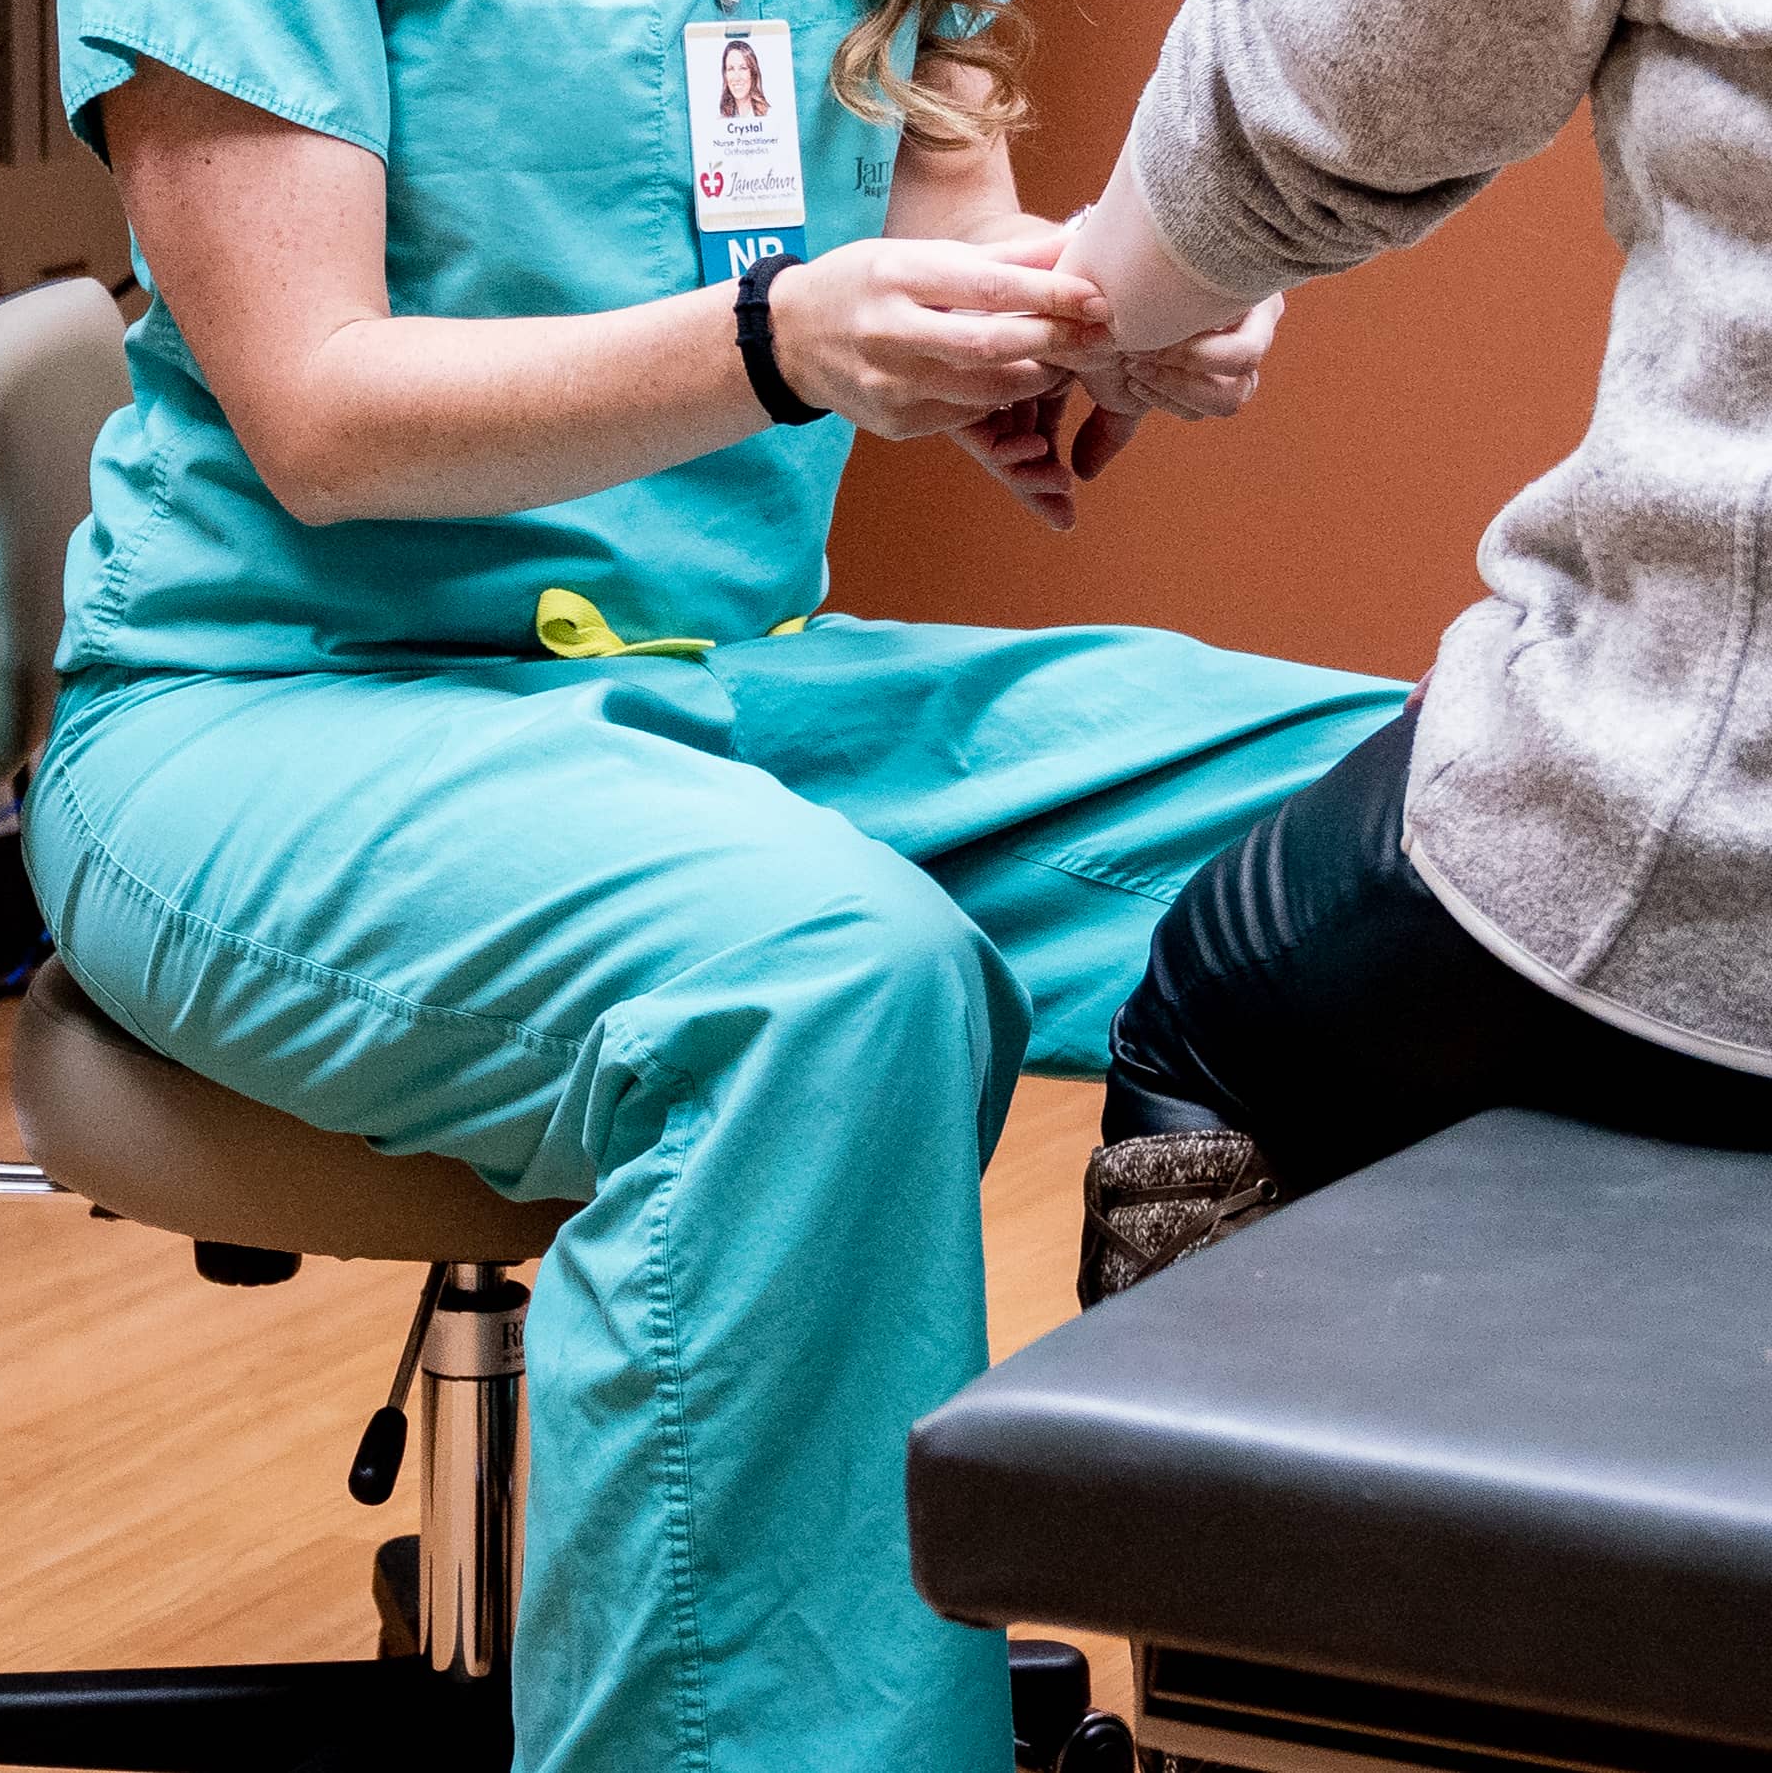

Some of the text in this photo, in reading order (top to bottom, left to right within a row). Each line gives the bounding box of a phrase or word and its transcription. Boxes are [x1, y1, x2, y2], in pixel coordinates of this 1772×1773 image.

[727, 121, 763, 136] Crystal
[713, 137, 778, 148] Nurse Practitioner
[726, 168, 796, 197] Jamestown
[728, 236, 784, 277] NP
